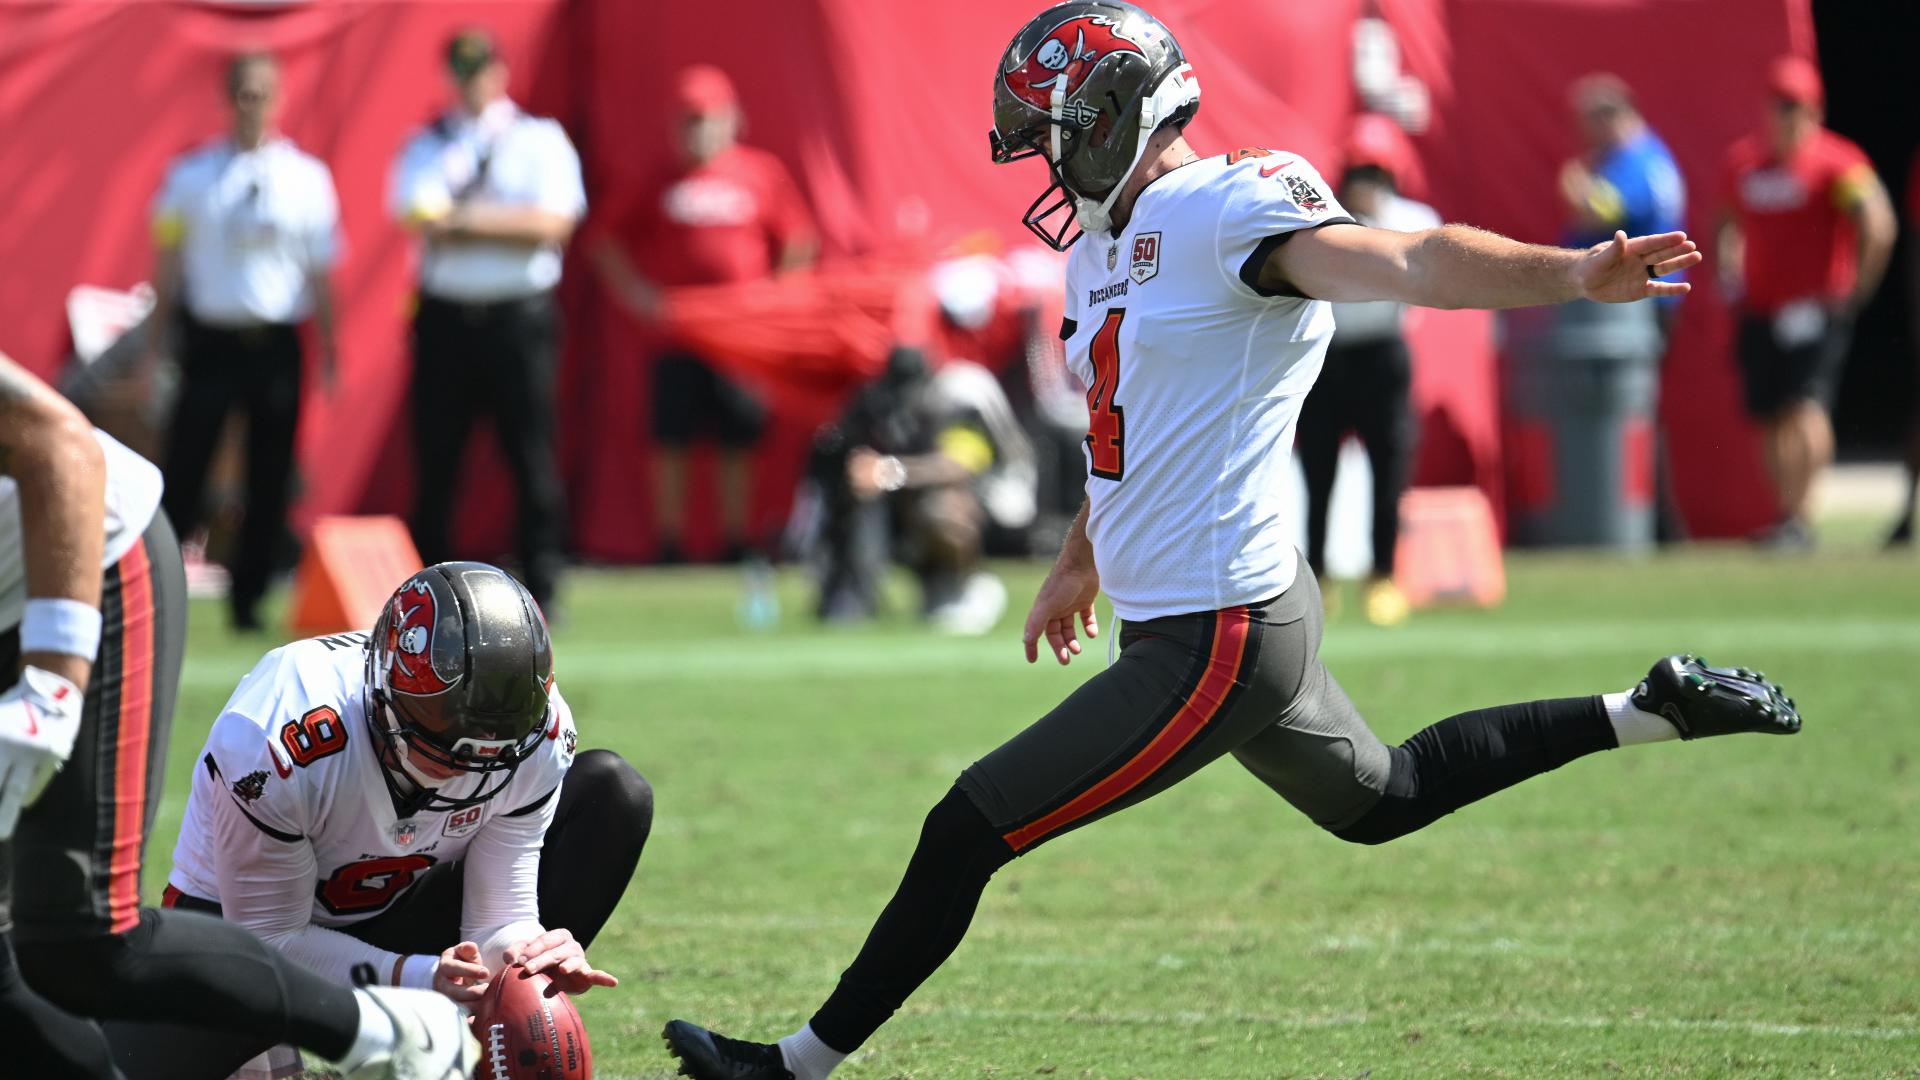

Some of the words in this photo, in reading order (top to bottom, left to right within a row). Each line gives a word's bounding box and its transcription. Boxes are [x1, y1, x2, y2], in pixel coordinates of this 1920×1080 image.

[1132, 237, 1157, 262] 50
[1088, 279, 1129, 307] BUCCANEERS
[1086, 307, 1126, 482] 4
[280, 704, 349, 769] 9
[448, 806, 481, 829] 50
[566, 1032, 576, 1071] Wilson
